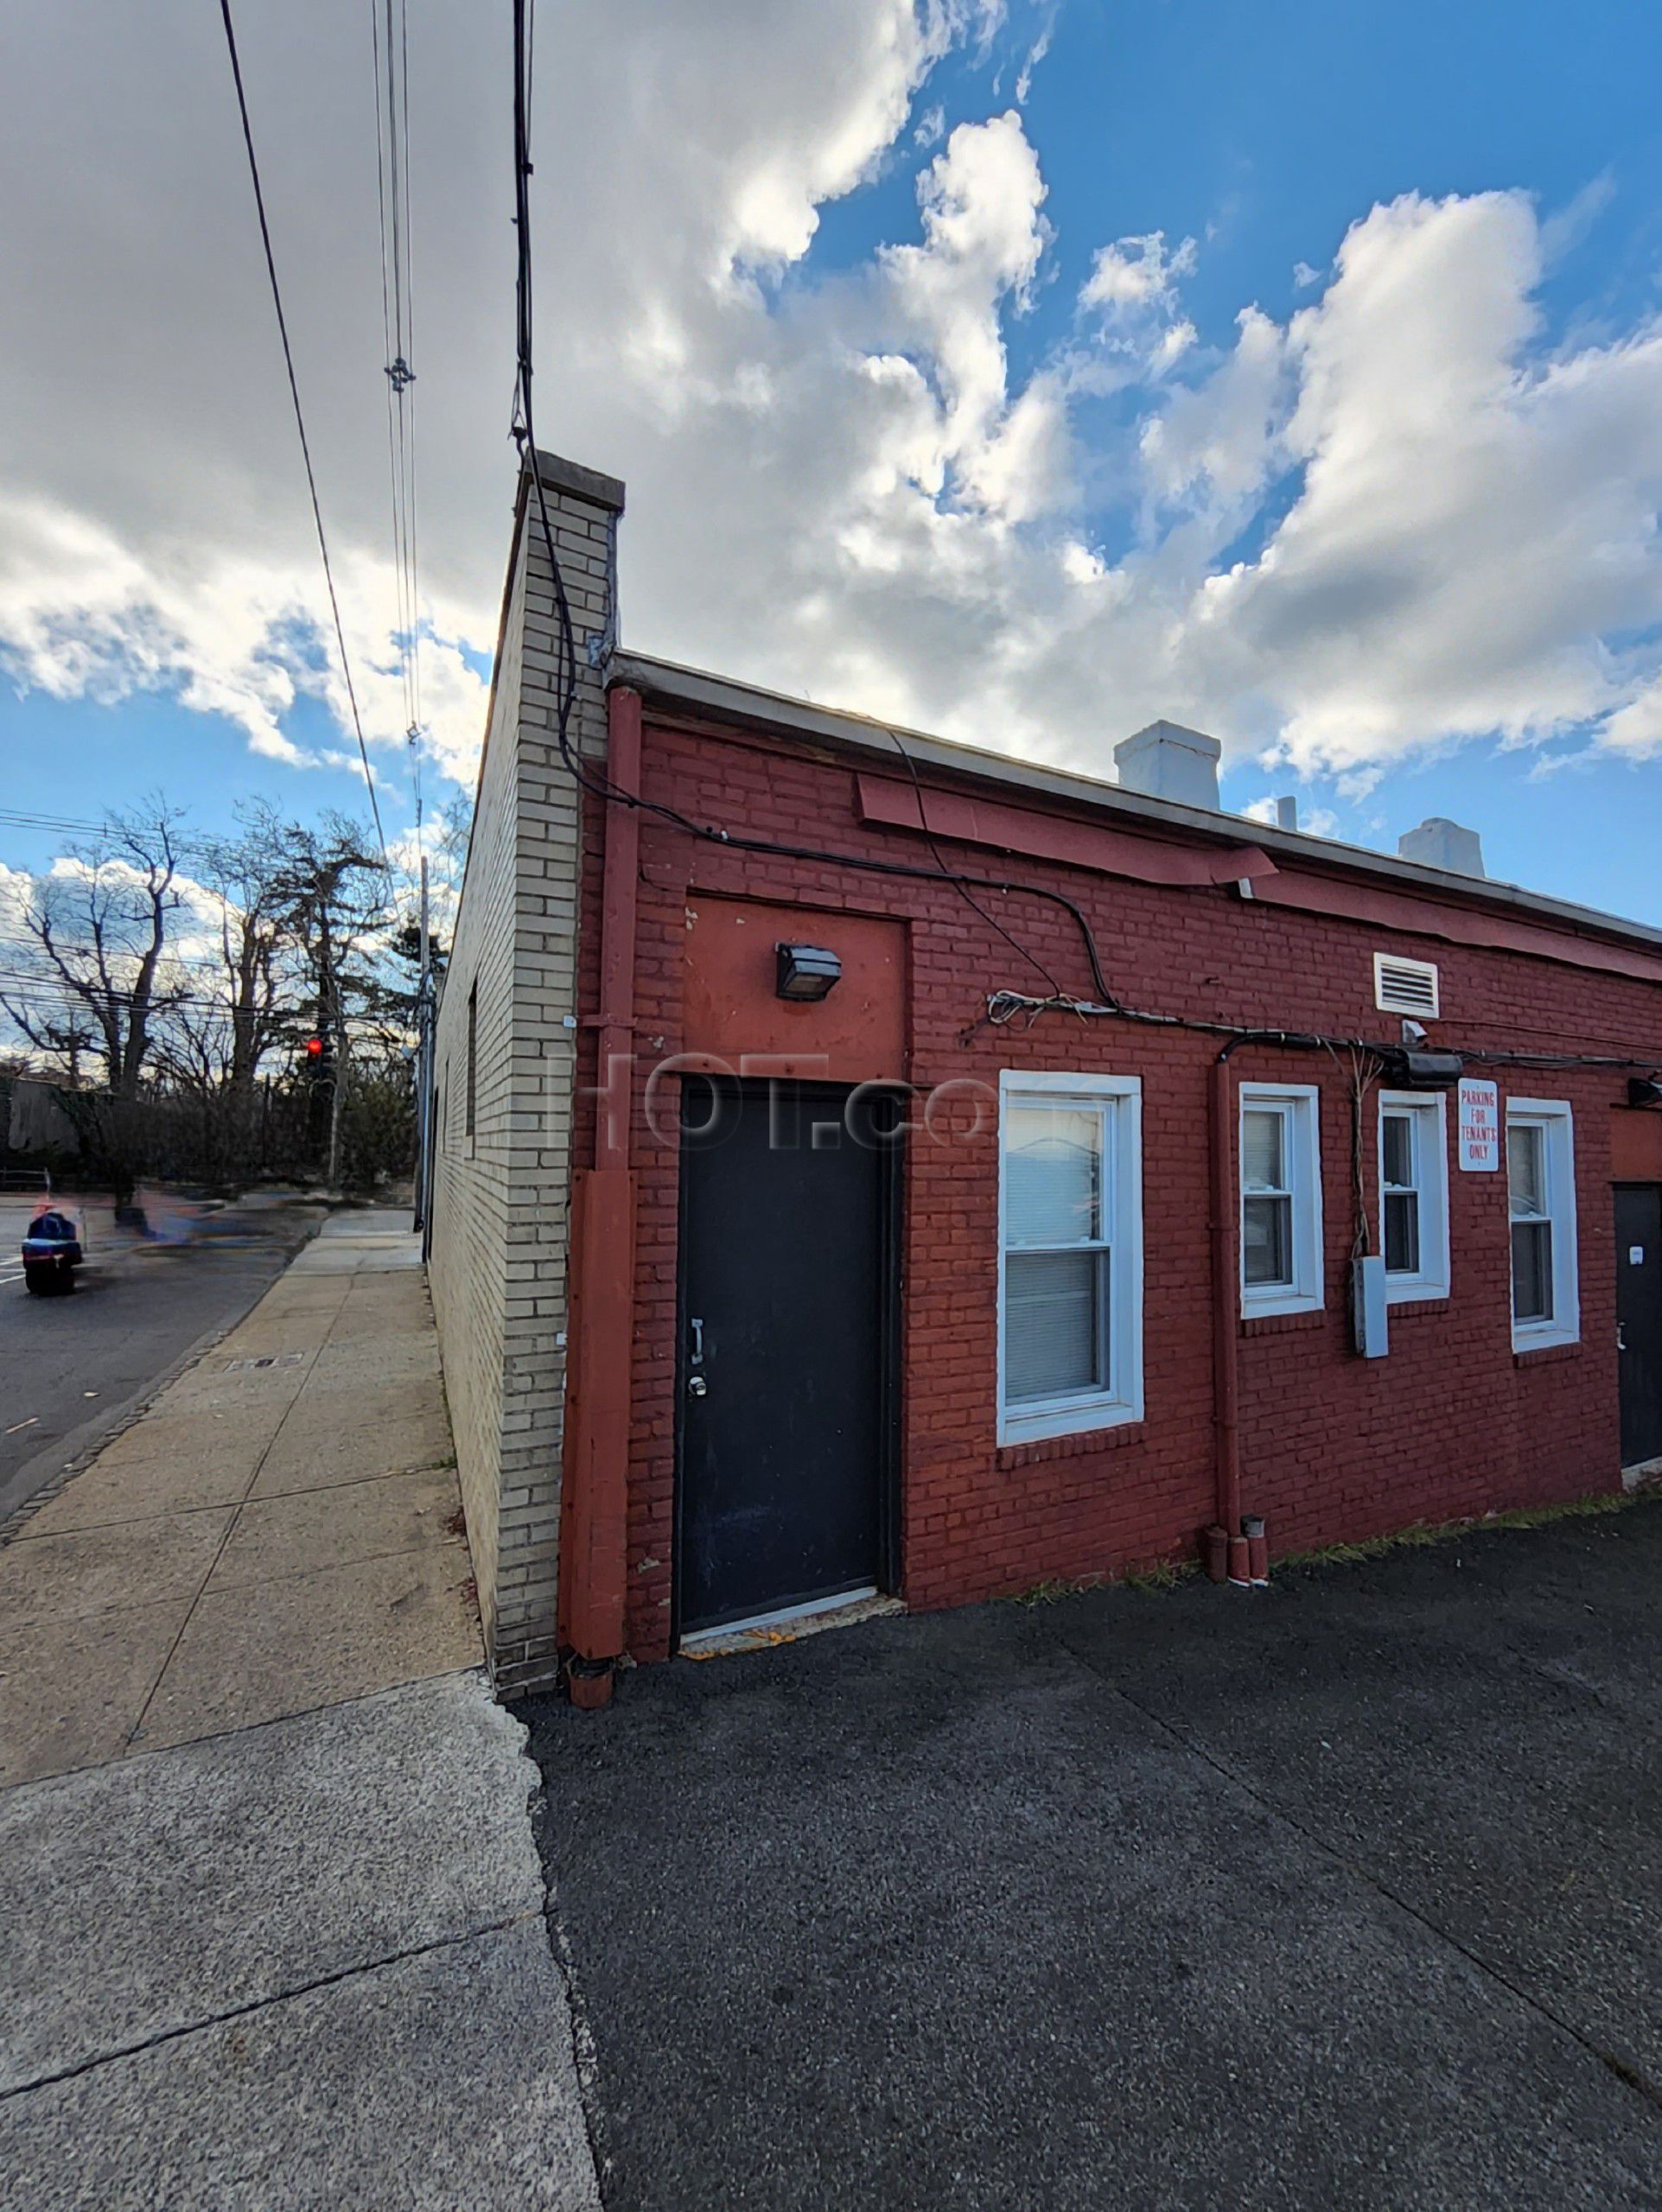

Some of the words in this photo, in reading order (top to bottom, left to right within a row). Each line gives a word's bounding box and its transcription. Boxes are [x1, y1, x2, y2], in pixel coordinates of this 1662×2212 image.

[1461, 1089, 1495, 1107] PARKING
[1471, 1109, 1486, 1124] FOR
[1461, 1126, 1496, 1142] TENANTS
[1469, 1145, 1489, 1160] ONLY
